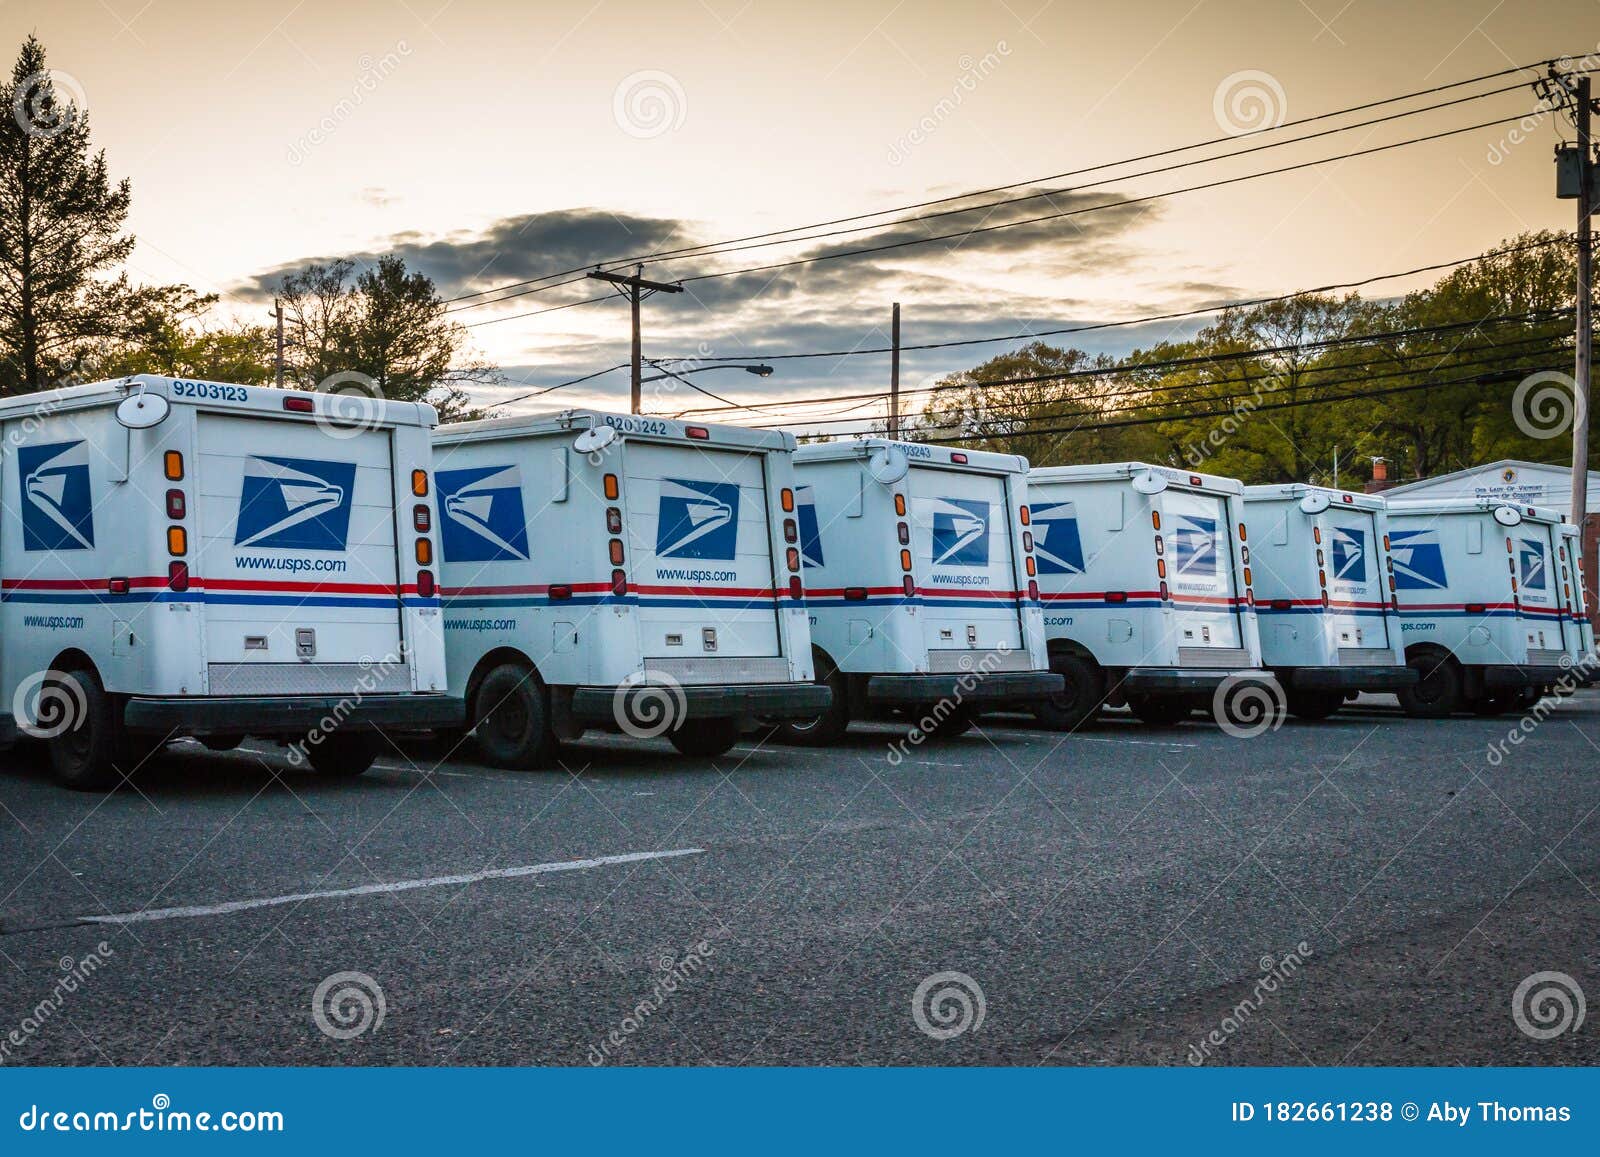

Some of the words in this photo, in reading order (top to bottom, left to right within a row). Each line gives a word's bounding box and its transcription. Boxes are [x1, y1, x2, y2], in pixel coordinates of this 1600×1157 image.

[173, 381, 248, 402] 9203123
[235, 556, 346, 574] www.usps.com
[656, 569, 737, 583] www.usps.com
[932, 575, 990, 587] www.usps.com
[24, 616, 84, 631] www.usps.com
[444, 619, 516, 632] www.usps.com
